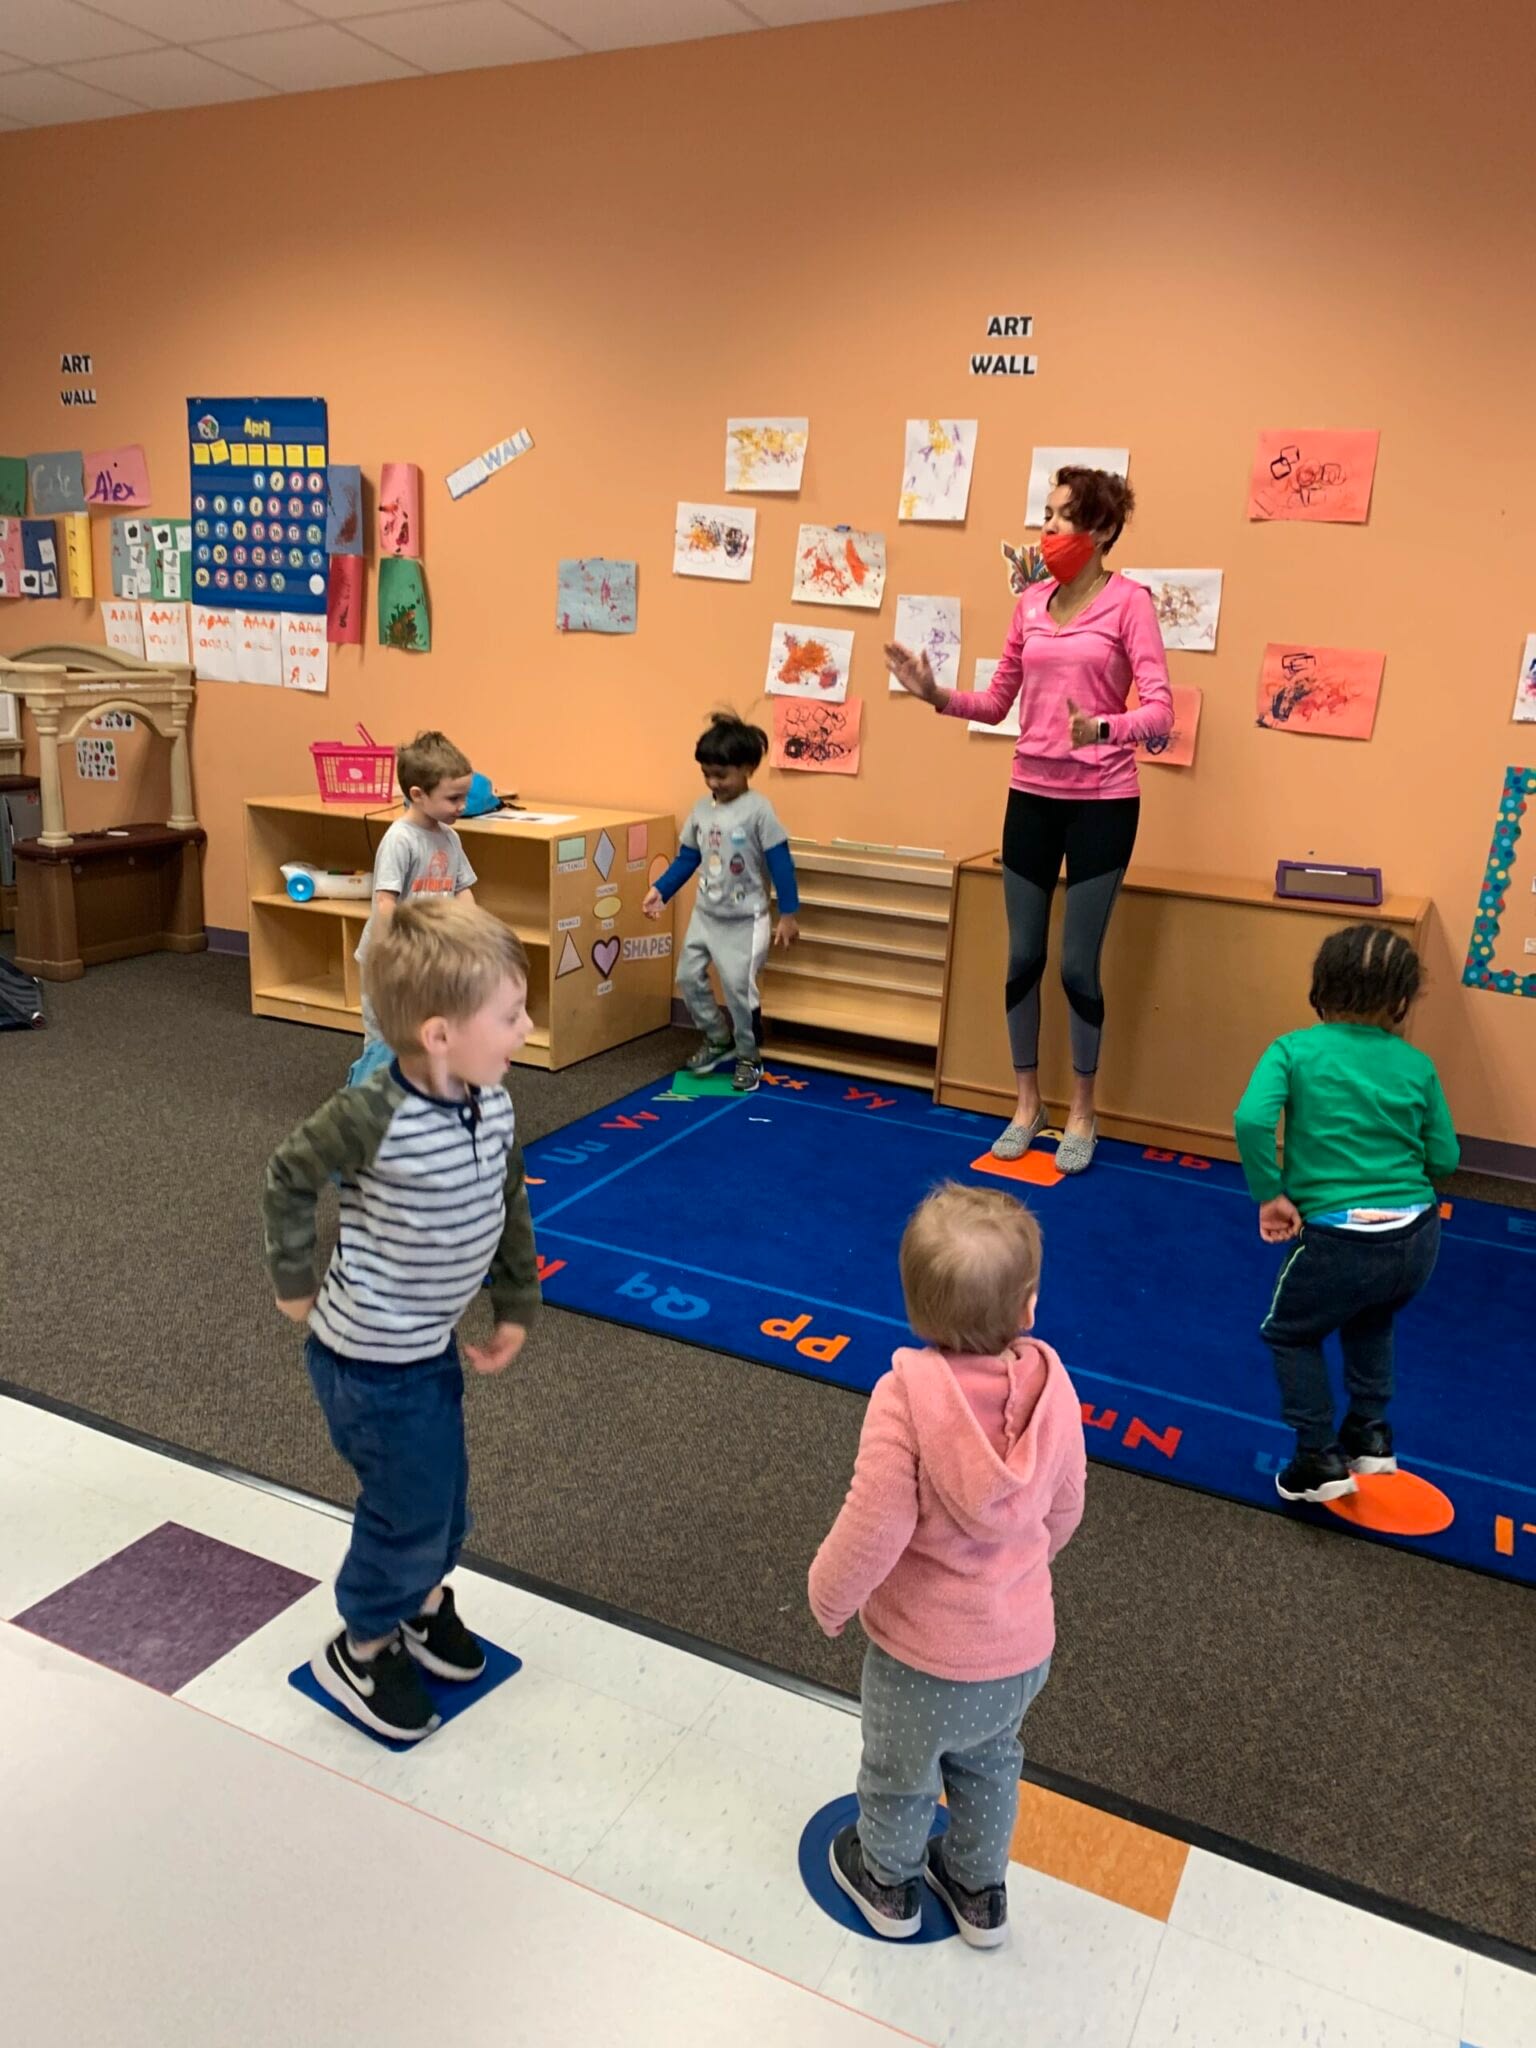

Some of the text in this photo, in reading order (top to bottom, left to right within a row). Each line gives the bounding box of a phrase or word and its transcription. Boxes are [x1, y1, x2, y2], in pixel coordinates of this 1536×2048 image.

[986, 316, 1032, 336] ART
[61, 355, 91, 374] ART
[971, 355, 1035, 375] WALL
[60, 390, 96, 406] WALL
[243, 416, 271, 438] April
[481, 431, 529, 471] WALL
[88, 470, 135, 502] Alex
[623, 935, 672, 959] SHAPES
[760, 1314, 851, 1363] Pp
